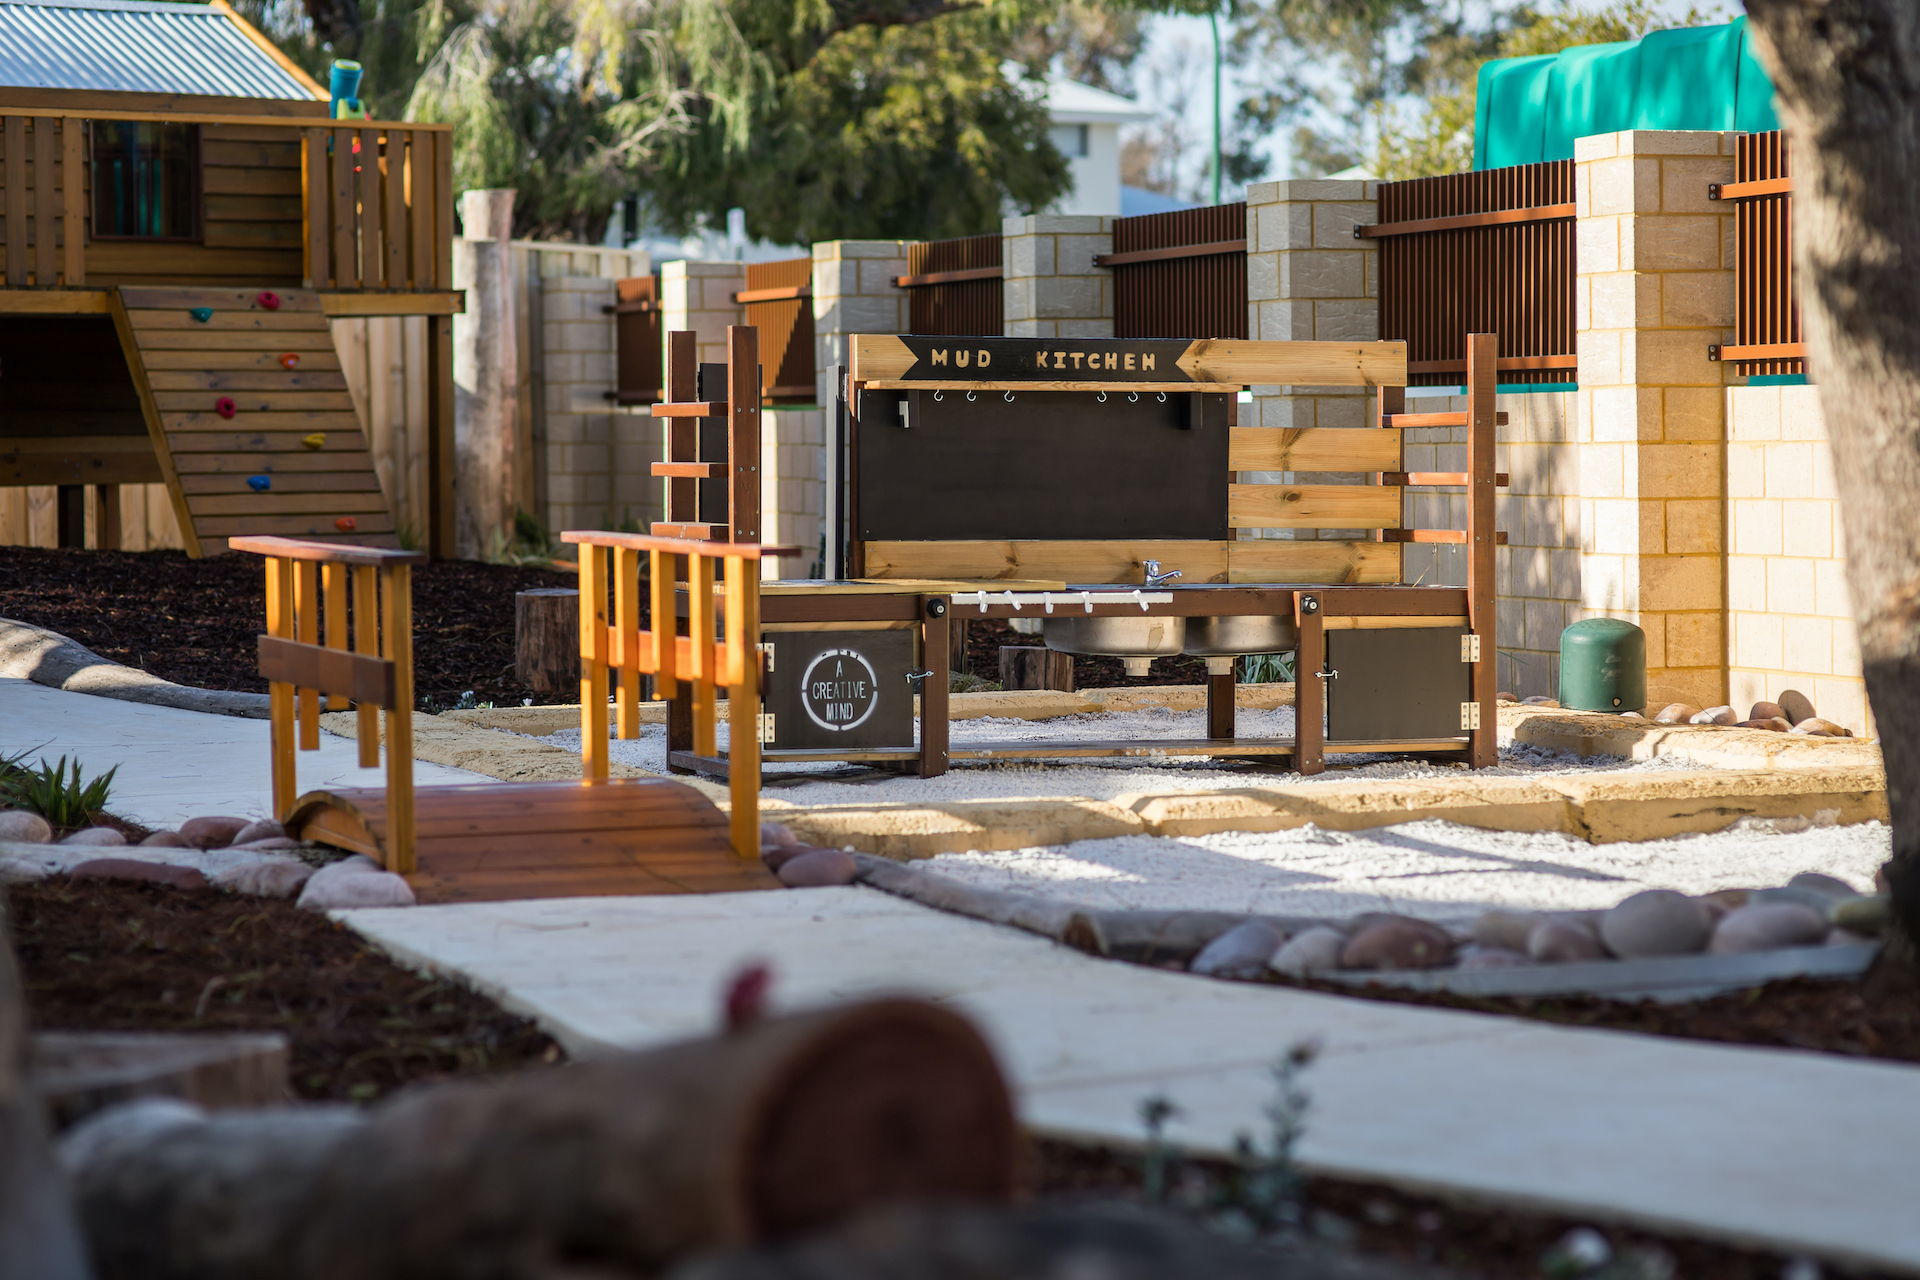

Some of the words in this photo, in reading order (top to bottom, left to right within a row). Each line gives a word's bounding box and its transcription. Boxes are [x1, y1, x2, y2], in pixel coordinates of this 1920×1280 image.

[931, 348, 992, 368] MUD
[1036, 350, 1156, 371] KITCHEN
[836, 660, 843, 678] A
[812, 681, 866, 700] CREATIVE
[826, 702, 853, 721] MIND
